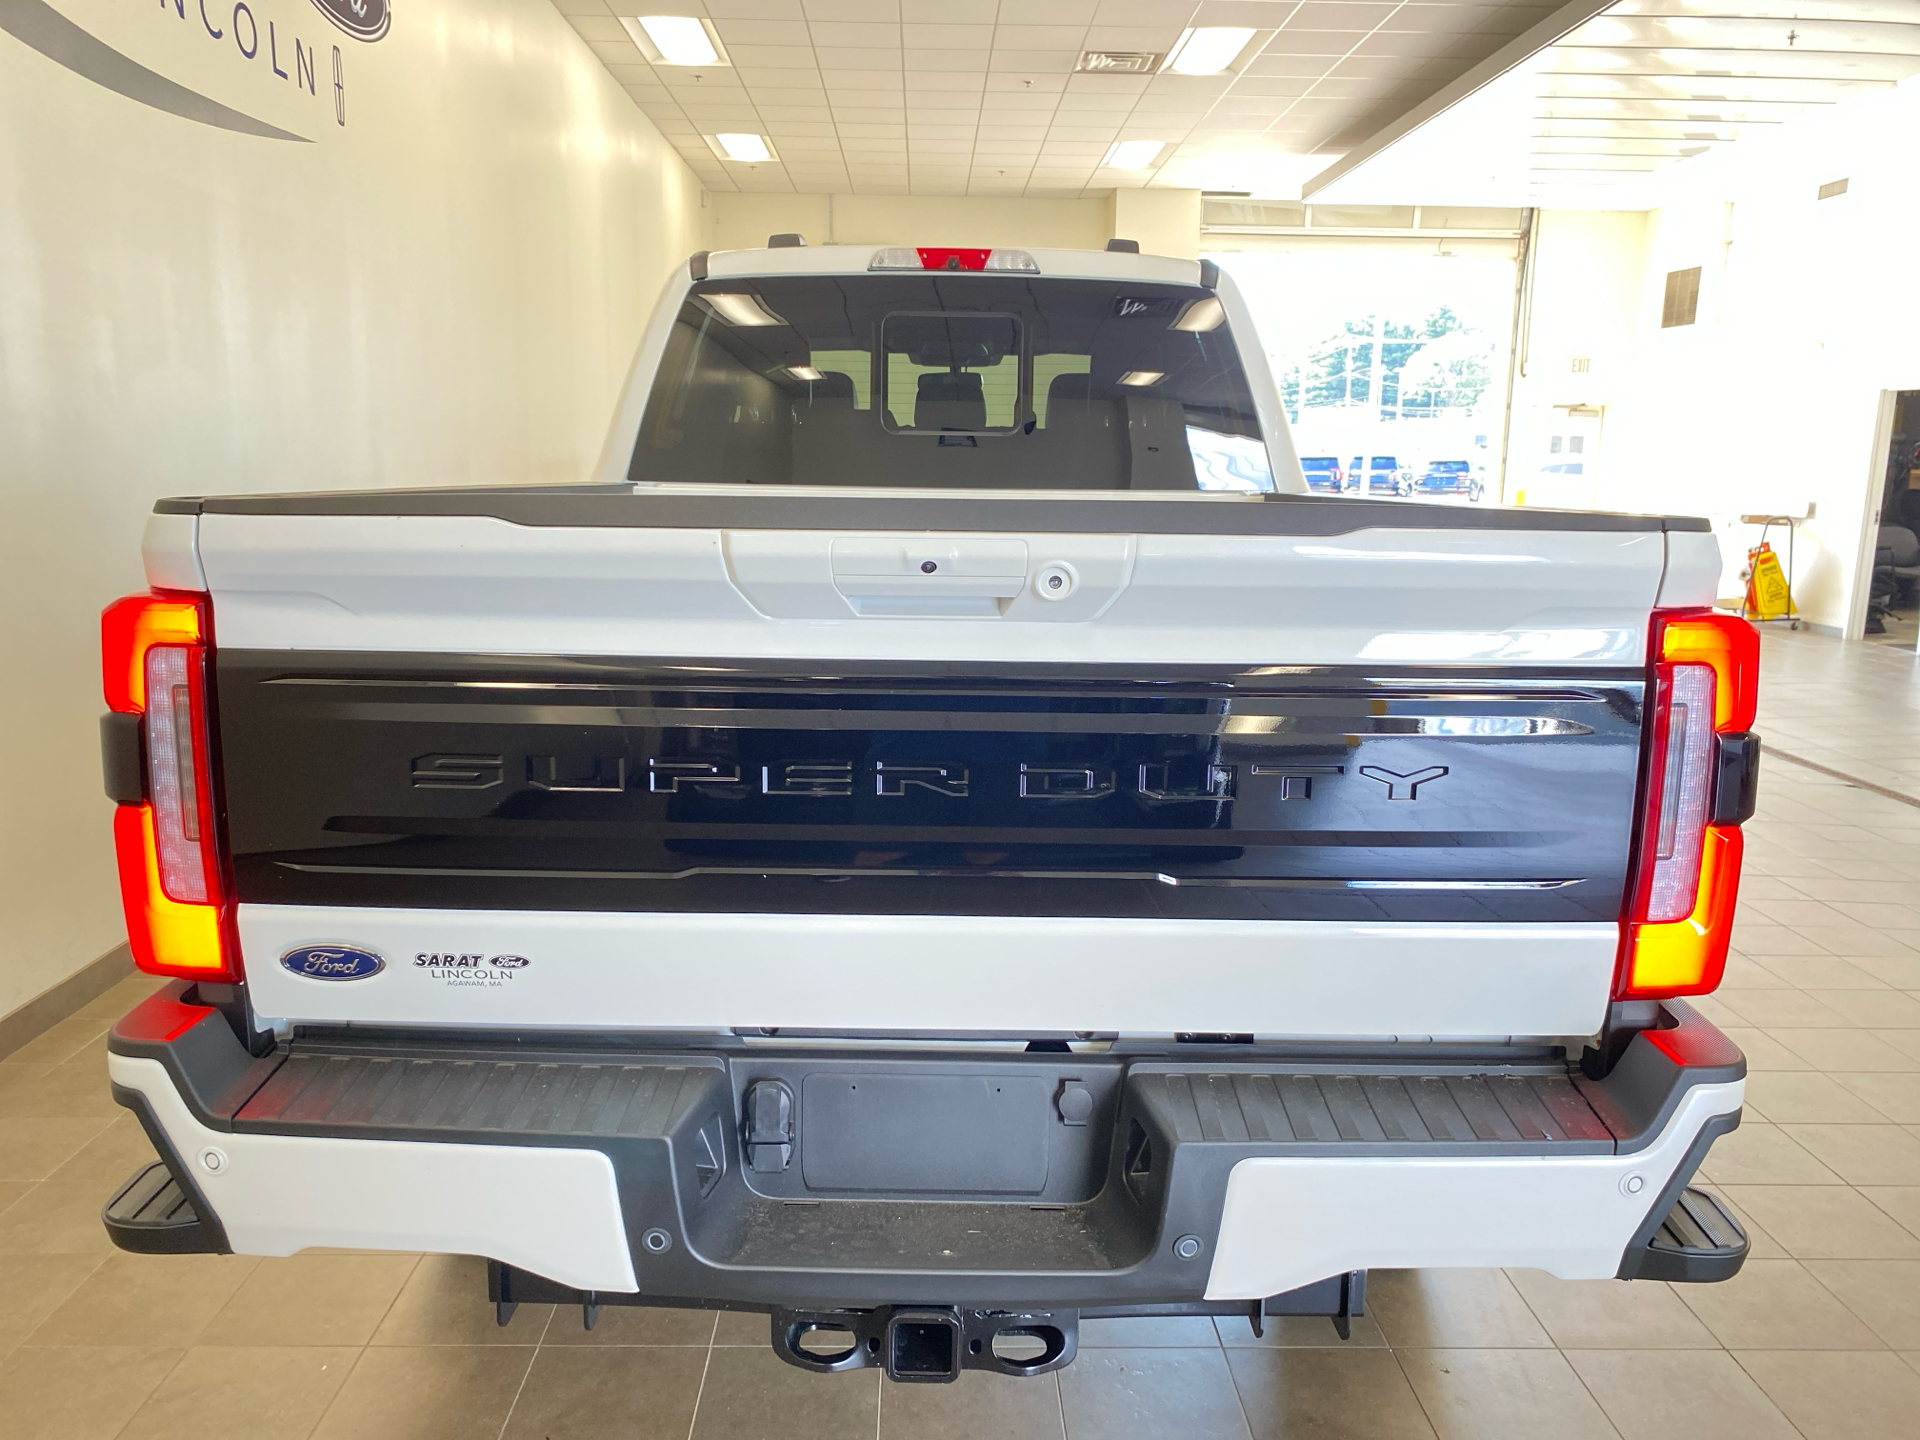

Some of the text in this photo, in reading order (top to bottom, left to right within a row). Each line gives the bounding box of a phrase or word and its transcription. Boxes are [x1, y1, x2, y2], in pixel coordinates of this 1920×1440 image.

[1571, 358, 1591, 373] EXIT
[410, 752, 1450, 802] SUPER DUTY
[304, 951, 360, 974] Ford
[414, 953, 524, 968] SARAT Ford
[431, 969, 513, 980] LINCOLN
[446, 980, 488, 988] AGAWAM,
